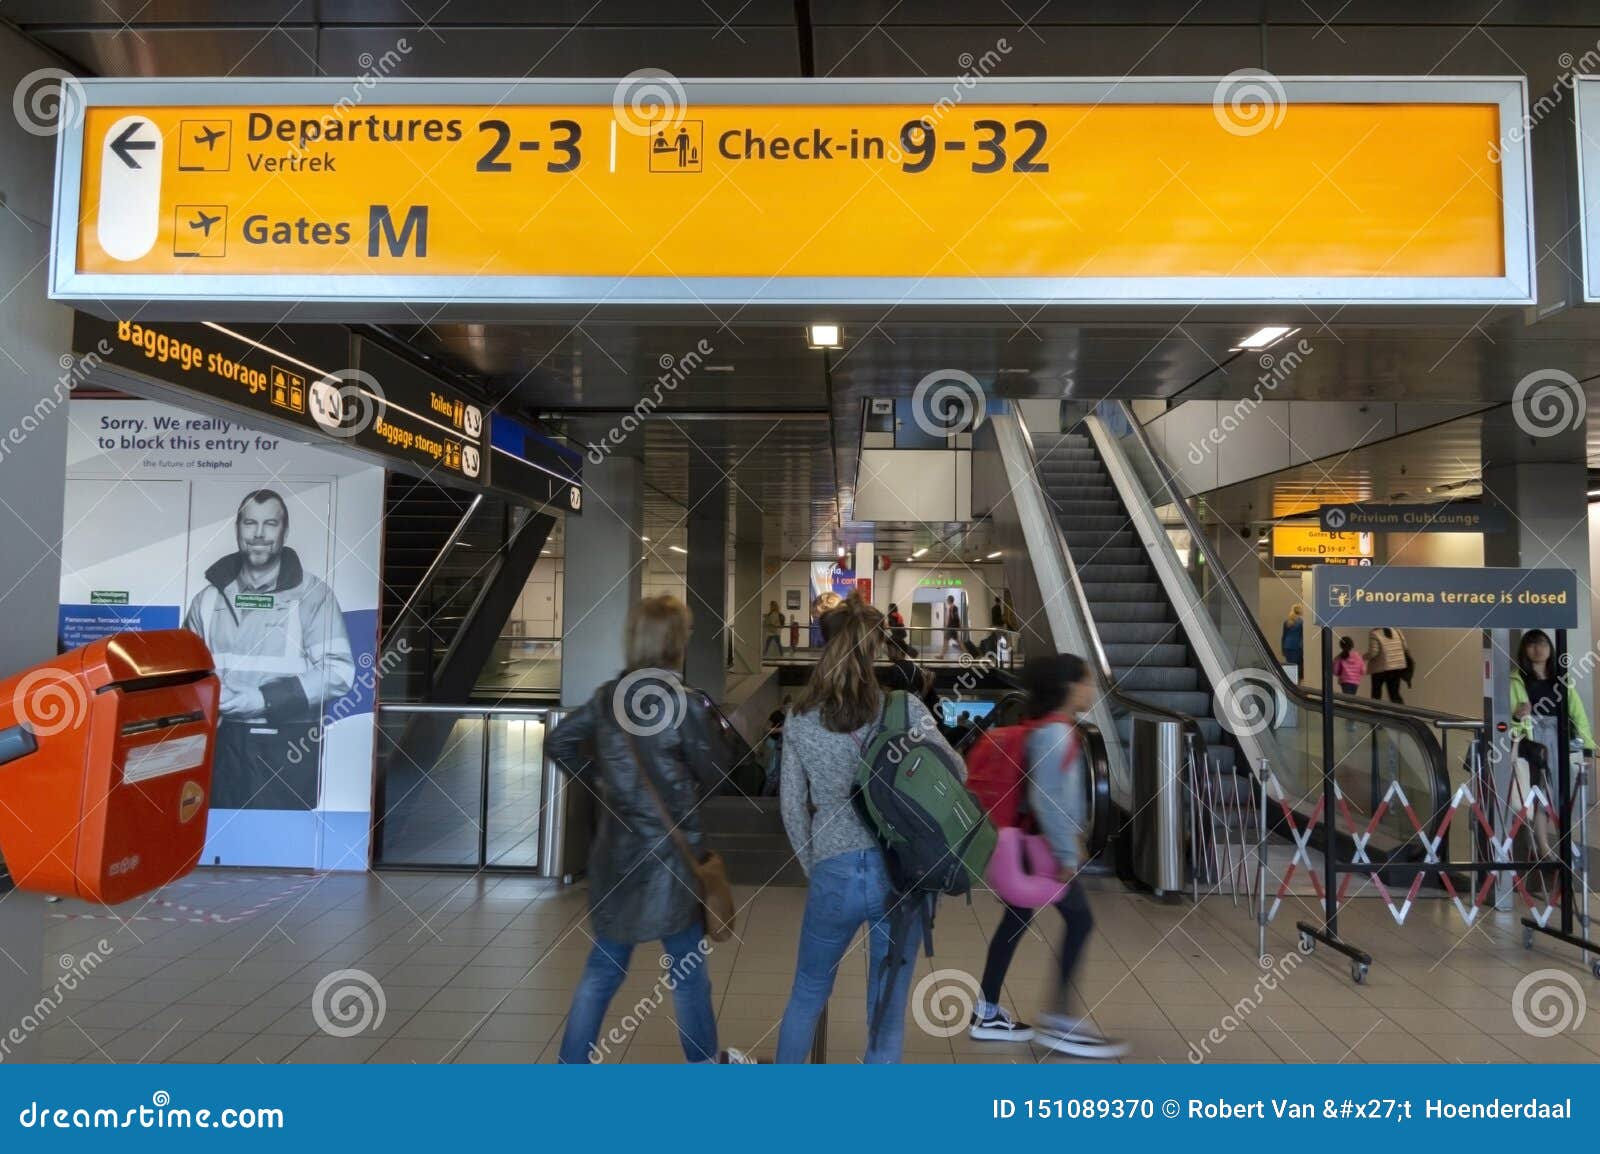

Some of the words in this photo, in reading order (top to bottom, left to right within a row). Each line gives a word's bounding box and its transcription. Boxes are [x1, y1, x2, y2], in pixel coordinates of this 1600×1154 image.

[248, 113, 463, 149] Departures
[477, 119, 582, 172] 2-3
[718, 128, 884, 159] Check-in
[900, 119, 1050, 173] 9-32
[247, 153, 336, 171] Vertrek
[242, 214, 351, 244] Gates
[367, 205, 429, 257] M
[118, 320, 203, 371] Baggage
[208, 352, 267, 393] storage
[430, 392, 452, 417] Toilets
[101, 416, 147, 432] Sorry.
[154, 417, 180, 430] We
[186, 418, 231, 433] really
[98, 437, 115, 450] to
[121, 437, 164, 450] block
[170, 437, 200, 450] this
[206, 438, 249, 453] entry
[255, 437, 279, 450] for
[376, 416, 413, 449] Baggage
[414, 434, 443, 459] storage
[197, 460, 233, 469] Schiphol
[1350, 512, 1399, 523] Privium
[1318, 545, 1326, 553] D
[1356, 589, 1435, 602] Panorama
[1441, 590, 1495, 603] terrace
[1501, 591, 1512, 603] is
[1518, 590, 1567, 604] closed
